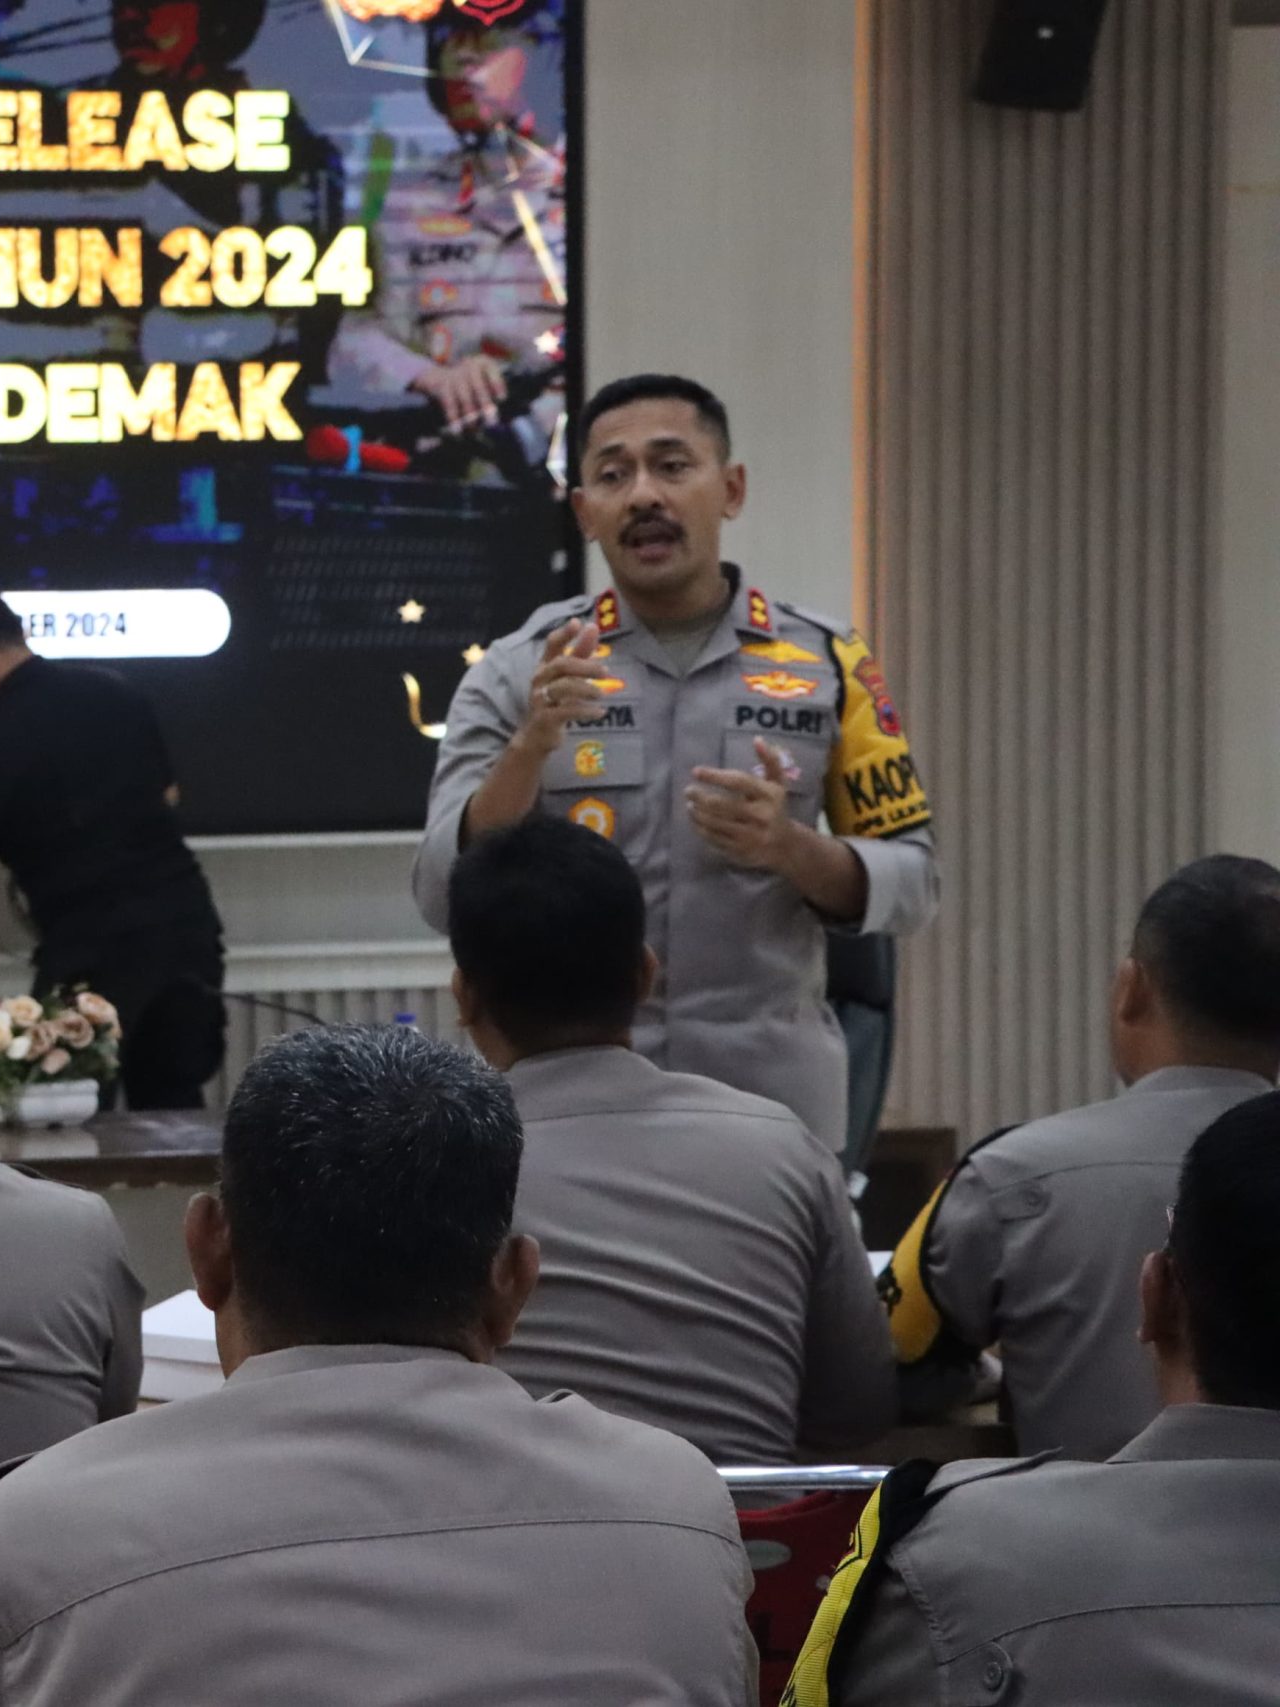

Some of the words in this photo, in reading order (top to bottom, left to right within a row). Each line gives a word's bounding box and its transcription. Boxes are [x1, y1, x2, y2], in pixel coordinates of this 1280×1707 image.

[159, 225, 373, 308] 2024
[65, 612, 127, 638] 2024
[736, 704, 822, 734] POLRI
